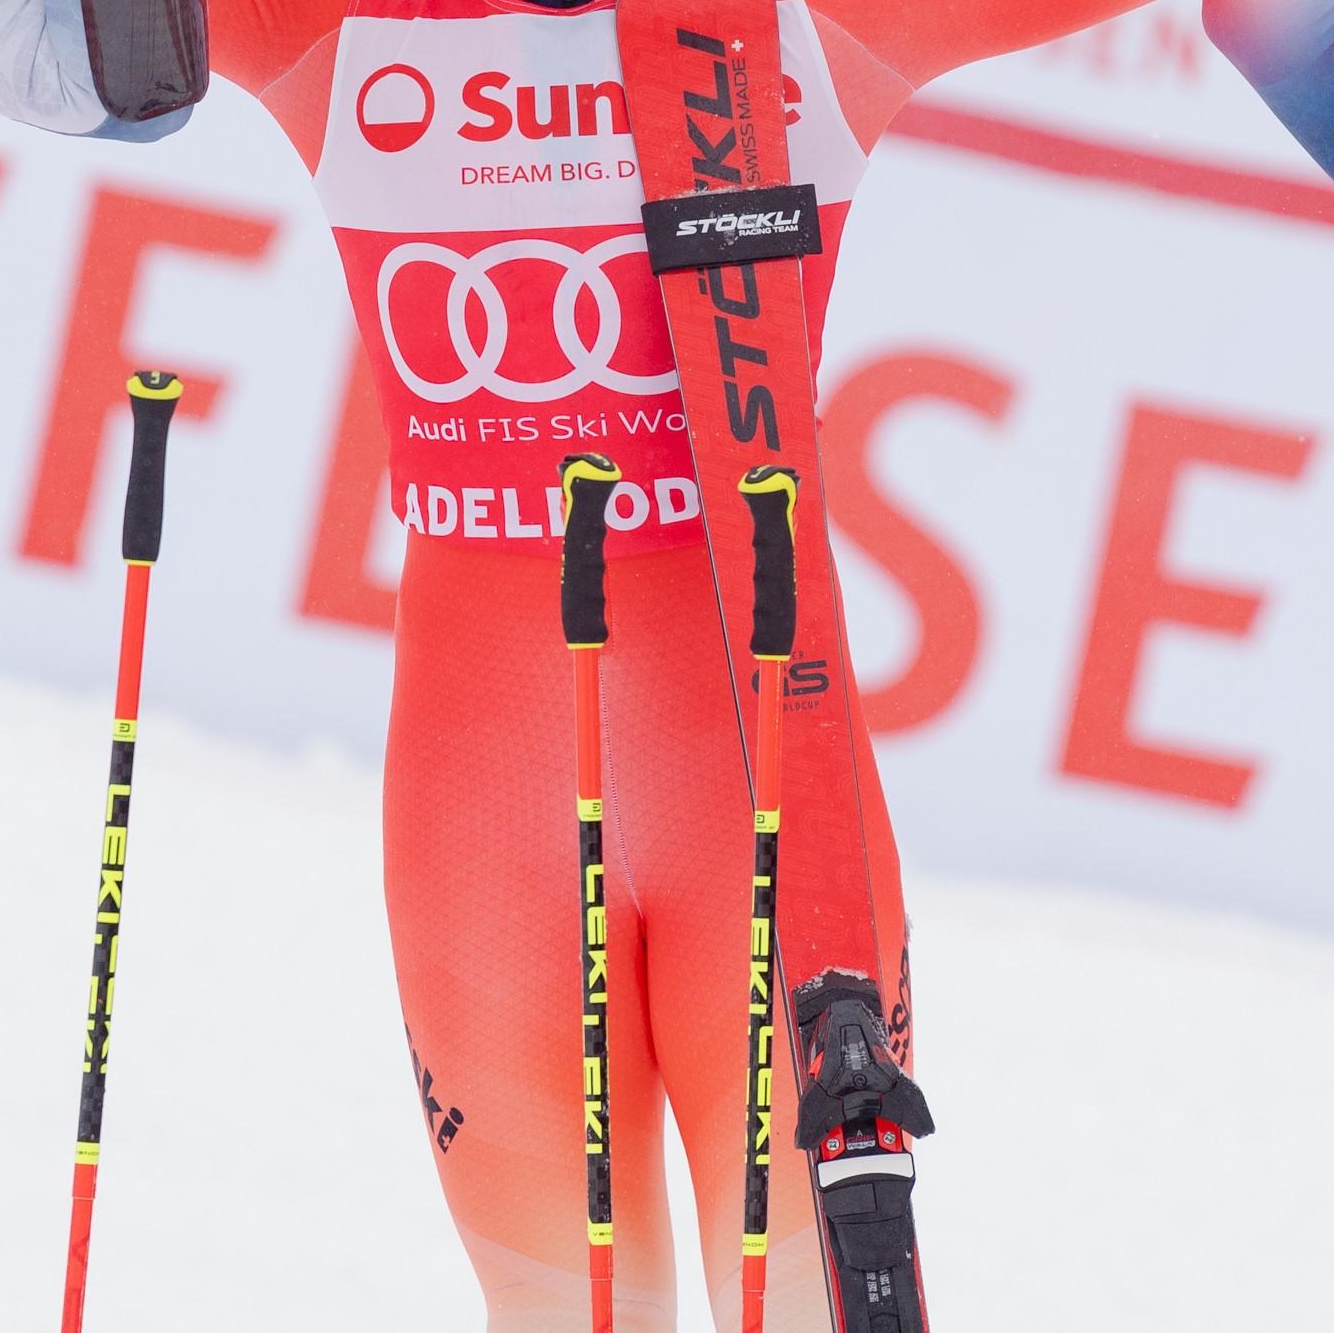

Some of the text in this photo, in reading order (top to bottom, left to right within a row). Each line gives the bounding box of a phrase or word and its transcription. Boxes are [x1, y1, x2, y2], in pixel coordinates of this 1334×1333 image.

[731, 56, 762, 184] SWISS MADE
[460, 164, 553, 186] DREAM
[561, 162, 611, 182] BIG.
[675, 209, 801, 237] STÖCKLI
[738, 224, 799, 237] RACING TEAM
[408, 414, 468, 442] Audi
[478, 416, 540, 442] FIS
[549, 412, 608, 440] Ski
[98, 783, 131, 924] LEKI
[585, 863, 609, 1004] LEKI
[754, 1024, 775, 1166] LEKI
